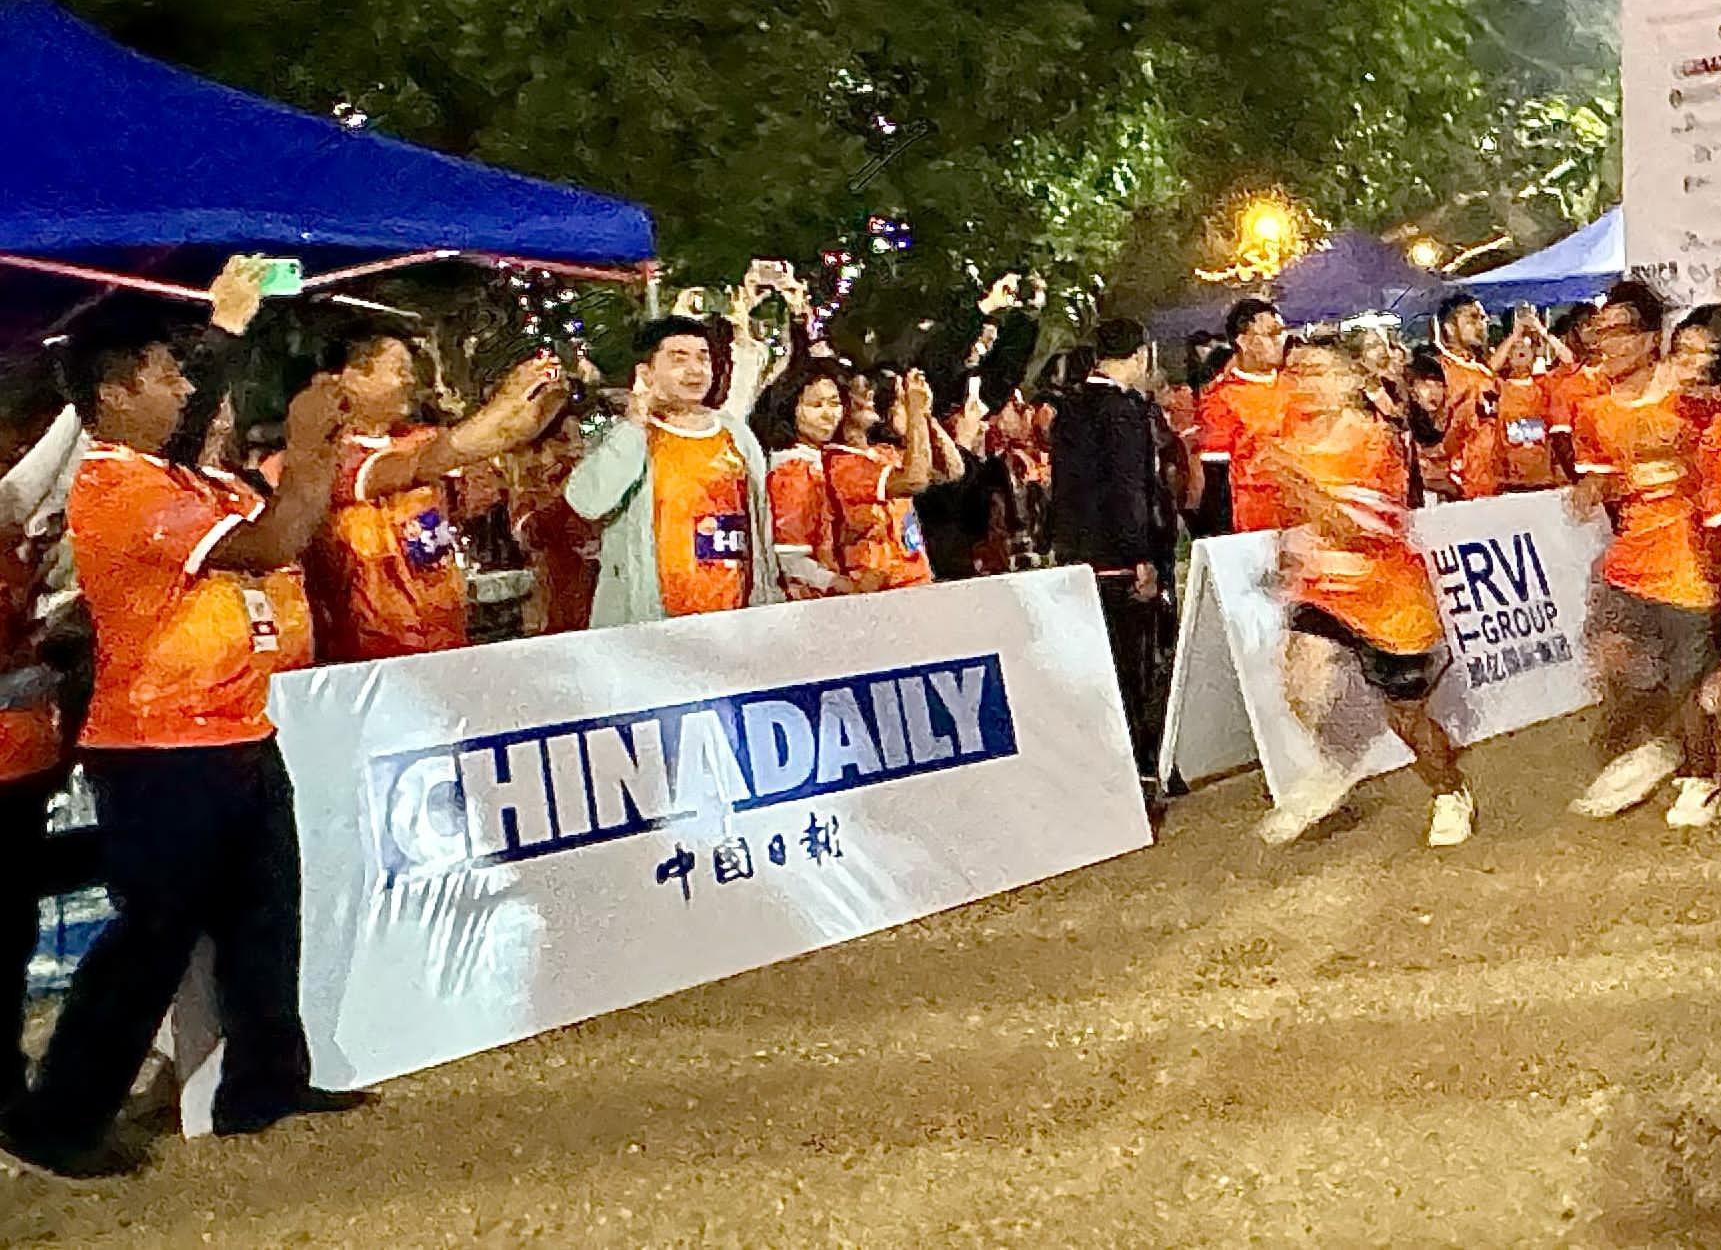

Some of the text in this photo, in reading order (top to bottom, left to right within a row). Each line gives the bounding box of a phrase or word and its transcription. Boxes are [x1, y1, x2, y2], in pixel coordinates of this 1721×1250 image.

[1431, 544, 1481, 654] THE
[1457, 531, 1551, 612] RVI
[1481, 601, 1558, 647] GROUP
